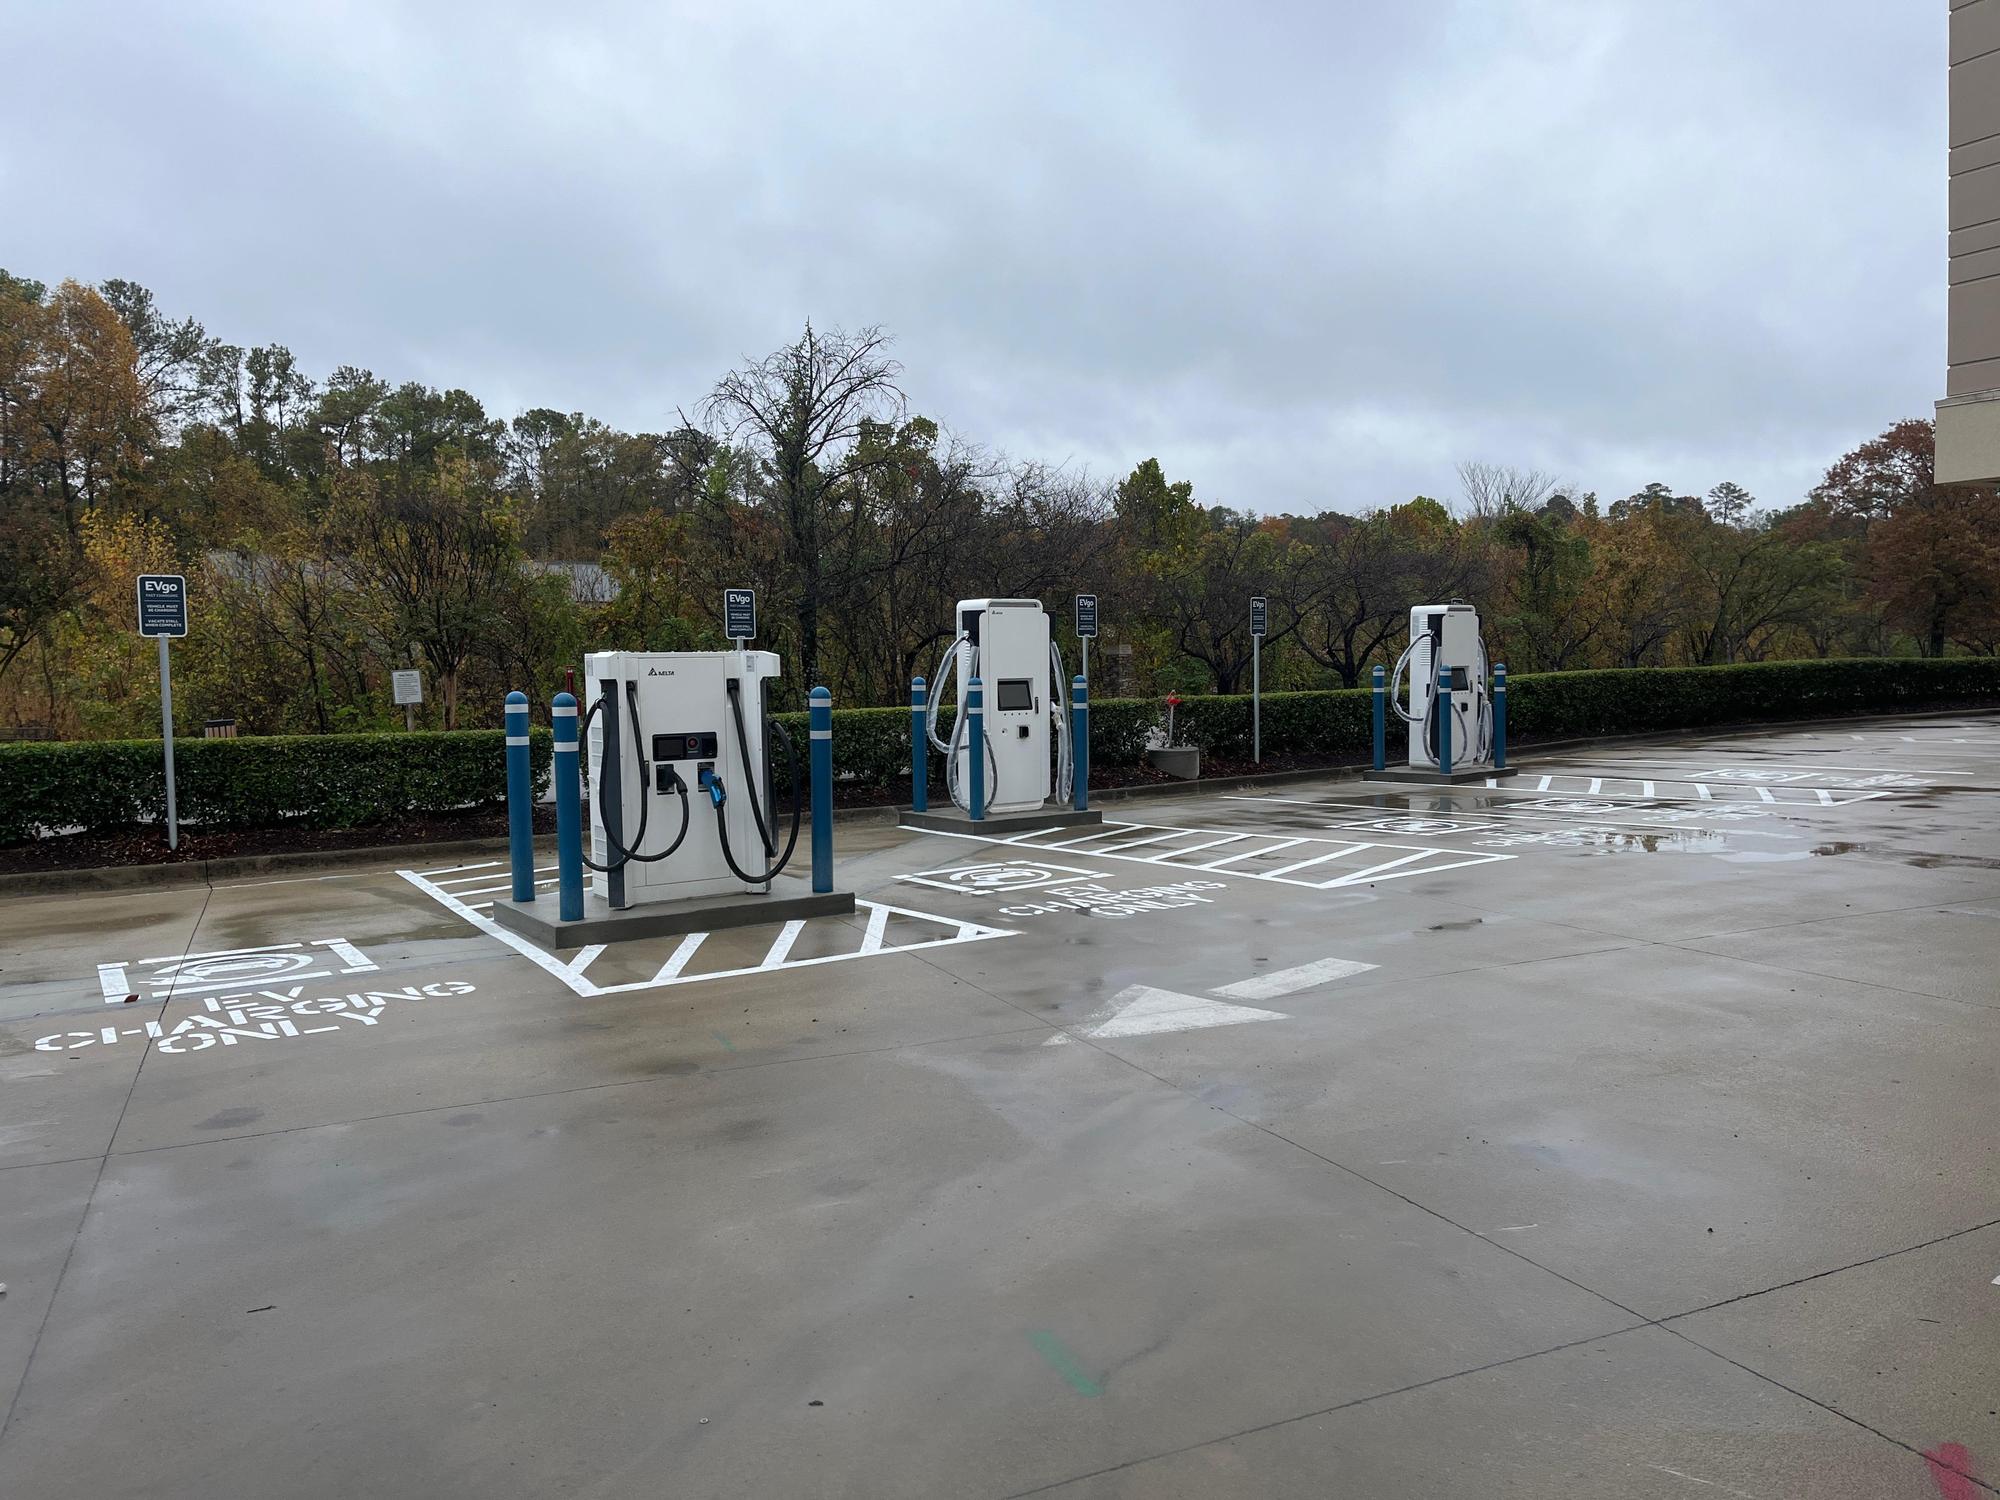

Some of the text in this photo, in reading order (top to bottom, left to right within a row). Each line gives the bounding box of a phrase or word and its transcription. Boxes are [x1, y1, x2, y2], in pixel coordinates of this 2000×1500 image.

[145, 581, 178, 593] EVgo
[730, 594, 750, 604] EVgo
[204, 986, 304, 1012] EV
[34, 981, 477, 1051] CHARGING
[158, 1006, 385, 1054] ONLY
